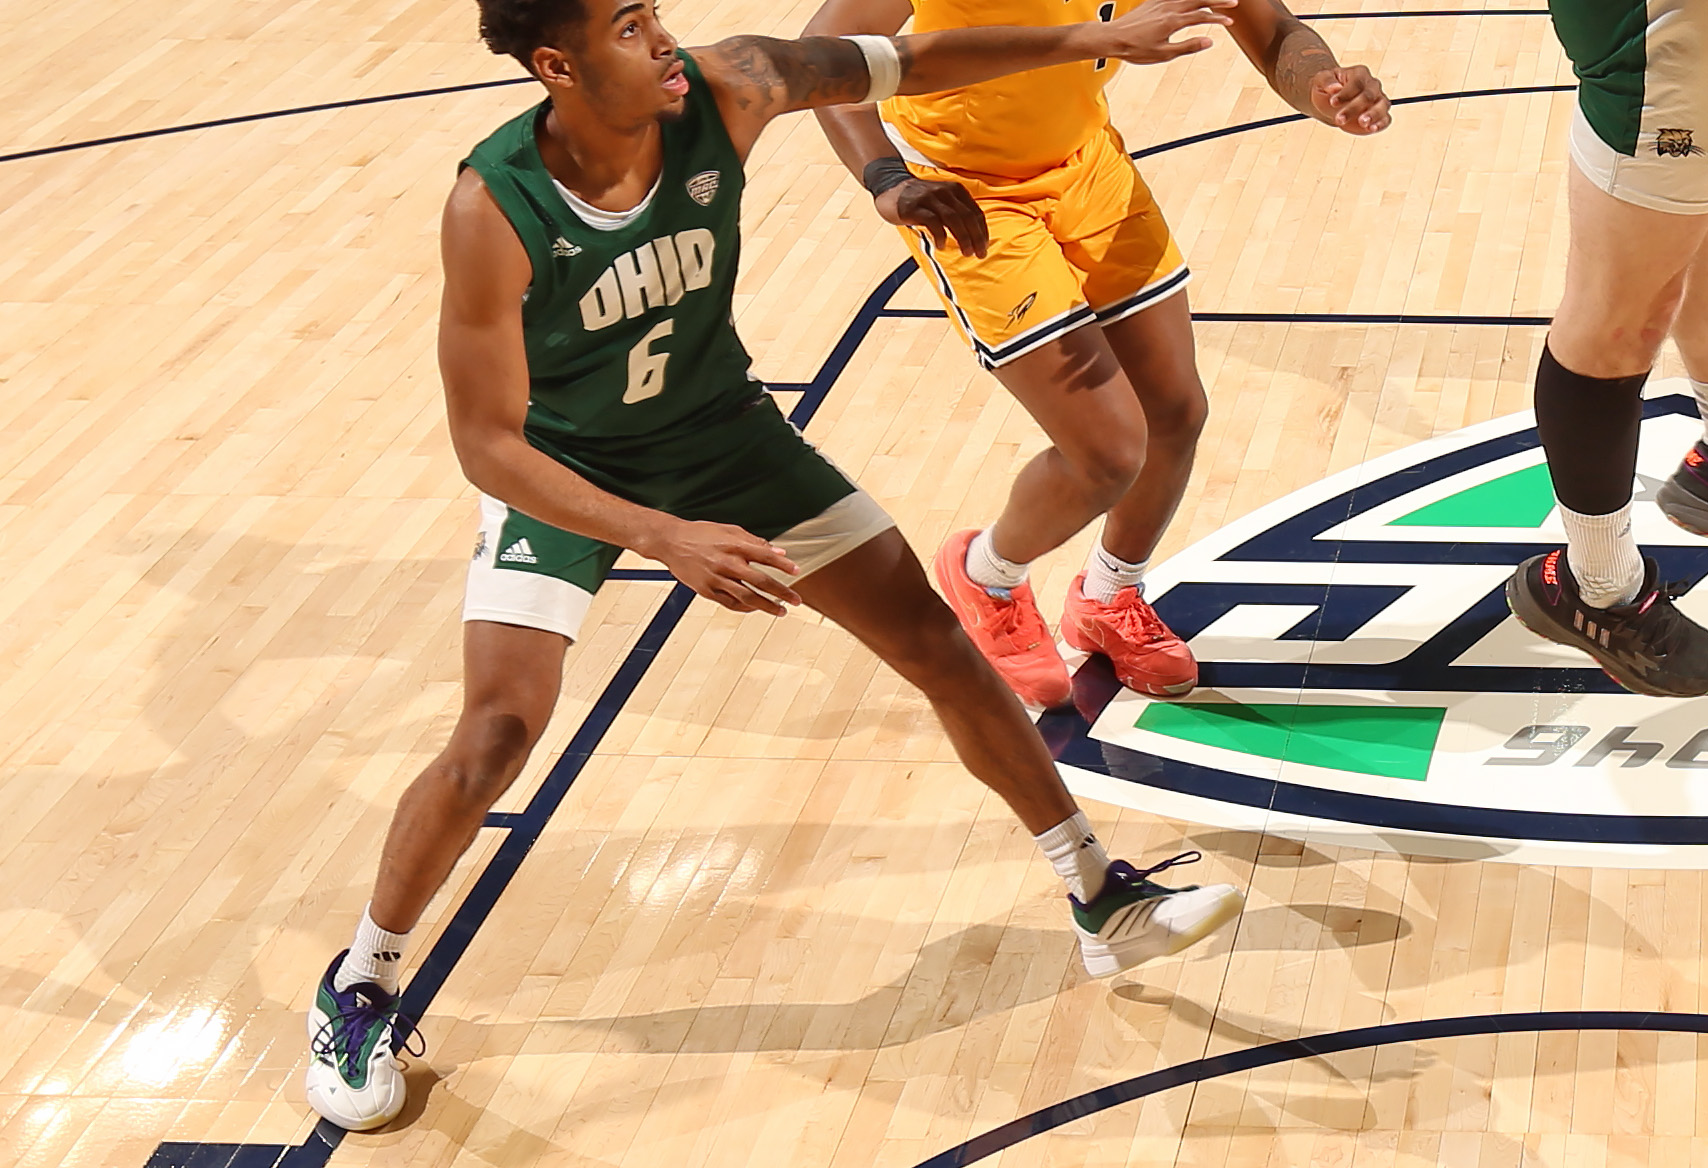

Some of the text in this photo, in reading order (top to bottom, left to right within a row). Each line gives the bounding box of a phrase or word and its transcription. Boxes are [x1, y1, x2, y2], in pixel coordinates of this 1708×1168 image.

[691, 181, 719, 195] MAC
[579, 228, 715, 331] OHIO
[622, 318, 674, 405] 6
[500, 553, 538, 564] adidas
